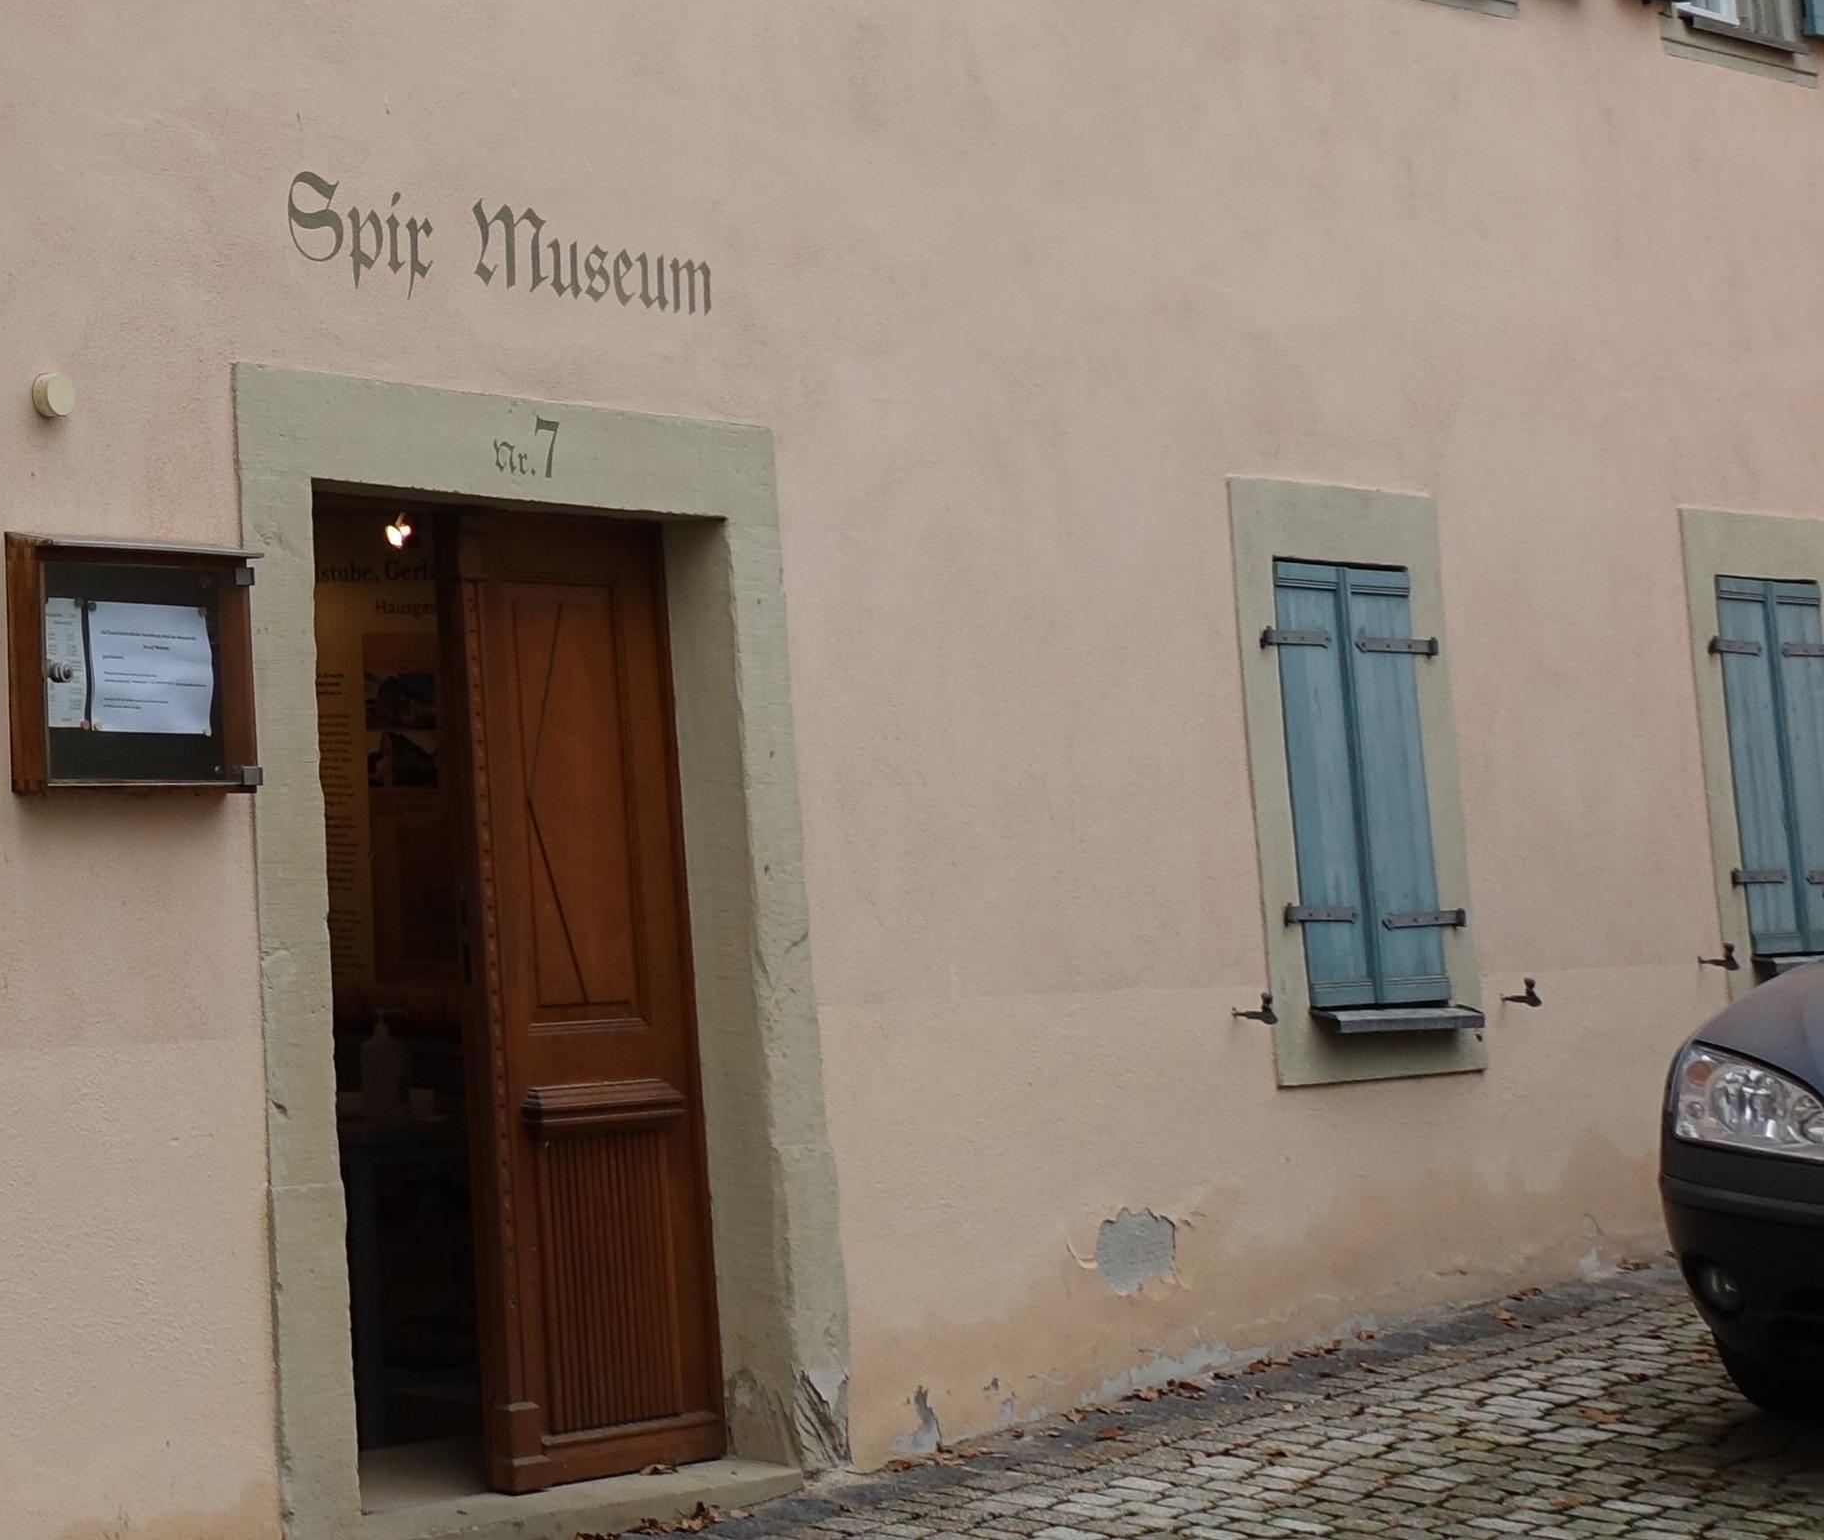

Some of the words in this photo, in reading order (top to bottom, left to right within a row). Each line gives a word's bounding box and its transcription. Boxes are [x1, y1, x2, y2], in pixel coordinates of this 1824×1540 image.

[287, 170, 434, 301] Spix
[472, 198, 713, 316] Museum
[315, 560, 380, 583] stube,
